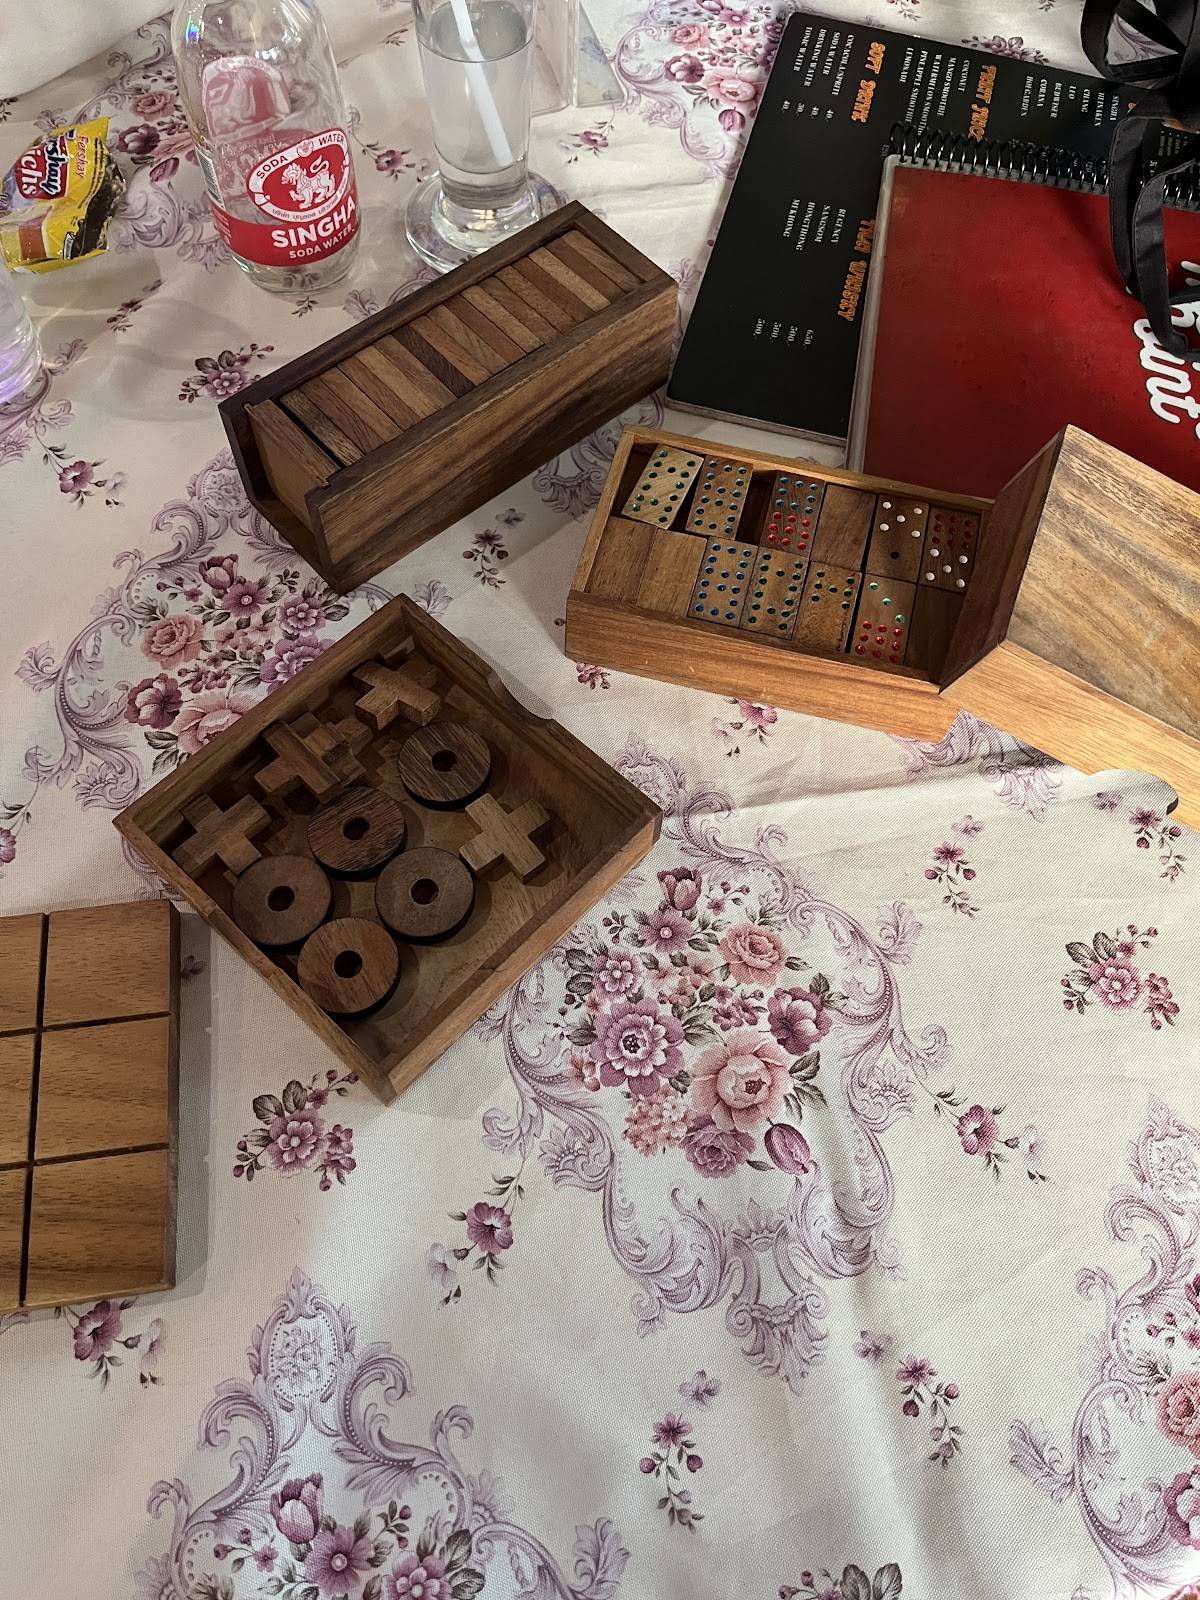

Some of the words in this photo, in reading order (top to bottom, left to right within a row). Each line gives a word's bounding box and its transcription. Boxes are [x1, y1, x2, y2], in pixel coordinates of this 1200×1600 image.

[801, 27, 812, 46] TONIC
[812, 29, 826, 60] DRINKING
[830, 32, 840, 49] SODA
[794, 48, 806, 71] WATER
[804, 63, 817, 86] WATER
[823, 51, 835, 75] WATER
[865, 42, 885, 74] SOFT
[899, 48, 913, 82] LEMONADE
[914, 51, 928, 85] PINEAPPLE
[946, 58, 956, 81] MANGO
[926, 55, 942, 100] WATERMELON
[958, 60, 969, 92] COCONUT
[976, 66, 996, 104] FRUIT
[1037, 79, 1047, 106] CORANA
[851, 80, 876, 122] DRINK
[905, 88, 919, 122] SMOOTHIE
[937, 82, 950, 115] SMOOTHIE
[1021, 76, 1033, 116] HOEGARDEN
[1082, 89, 1090, 112] CHANG
[1110, 96, 1118, 120] SINGHA
[74, 136, 89, 179] Fershay
[256, 155, 289, 179] SODA
[318, 133, 345, 146] WATER
[271, 196, 356, 248] SINGHA
[783, 200, 800, 237] MEKHONG
[796, 202, 815, 250] HONGTHONG
[815, 205, 830, 242] SANGSOM
[831, 209, 846, 242] REGENCY
[289, 245, 321, 259] SODA
[322, 225, 352, 249] WATER
[838, 261, 867, 321] WHISKY
